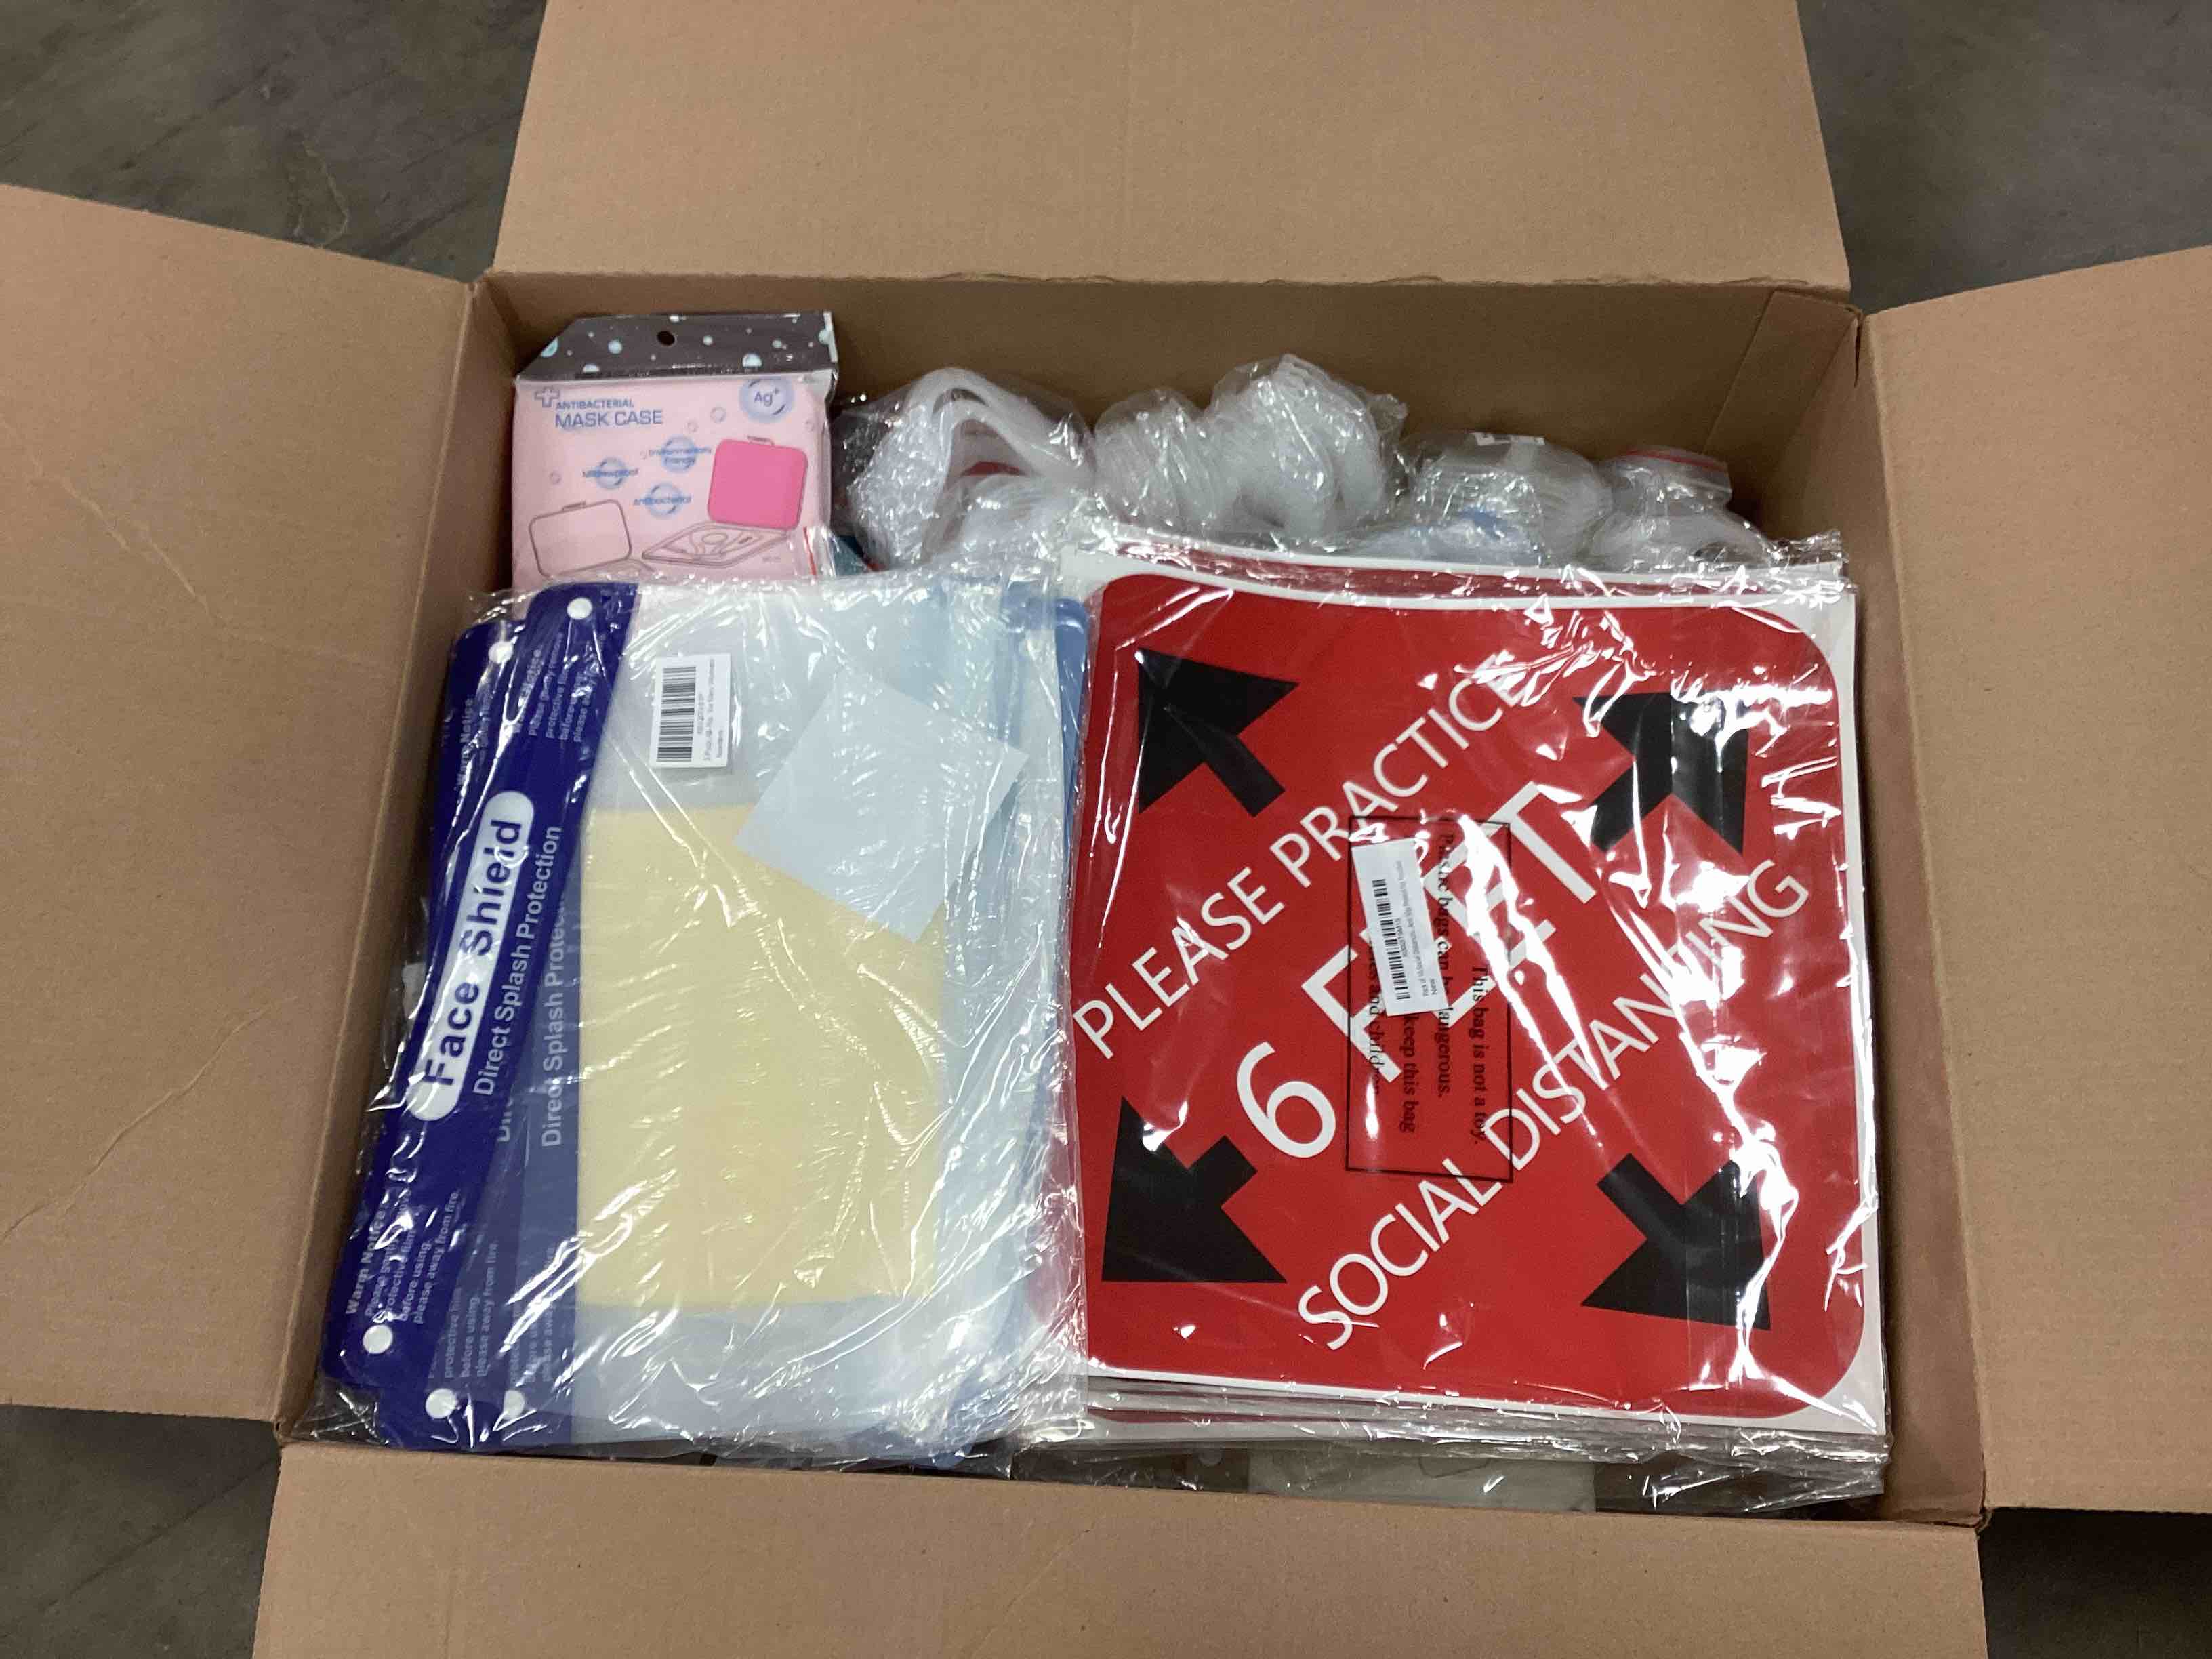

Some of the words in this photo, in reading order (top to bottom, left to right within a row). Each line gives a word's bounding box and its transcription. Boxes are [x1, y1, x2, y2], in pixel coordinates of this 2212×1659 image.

[554, 411, 608, 429] MASK
[613, 409, 663, 426] CASE
[556, 400, 634, 410] ANTIBACTERIAL
[1072, 866, 1286, 1059] PLEASE
[1269, 668, 1530, 888] PRACTICE
[1434, 898, 1454, 936] bags
[423, 981, 479, 1086] Face
[459, 819, 524, 957] Shield
[474, 1026, 511, 1096] Direct
[495, 944, 531, 1019] Splash
[516, 826, 562, 939] Protection
[1437, 941, 1449, 970] can
[1368, 985, 1384, 1015] and
[1472, 966, 1488, 1002] This
[541, 989, 567, 1071] Splash
[1399, 1015, 1418, 1058] keep
[1469, 1007, 1488, 1040] bag
[1473, 1044, 1487, 1058] is
[1404, 1062, 1418, 1094] this
[1473, 1061, 1487, 1092] not
[1236, 1041, 1336, 1158] 6
[1473, 1096, 1484, 1107] a
[1399, 1100, 1418, 1133] bag
[435, 1216, 453, 1245] from
[426, 1247, 445, 1279] away
[1298, 1153, 1508, 1351] SOCIAL
[413, 1282, 434, 1324] please
